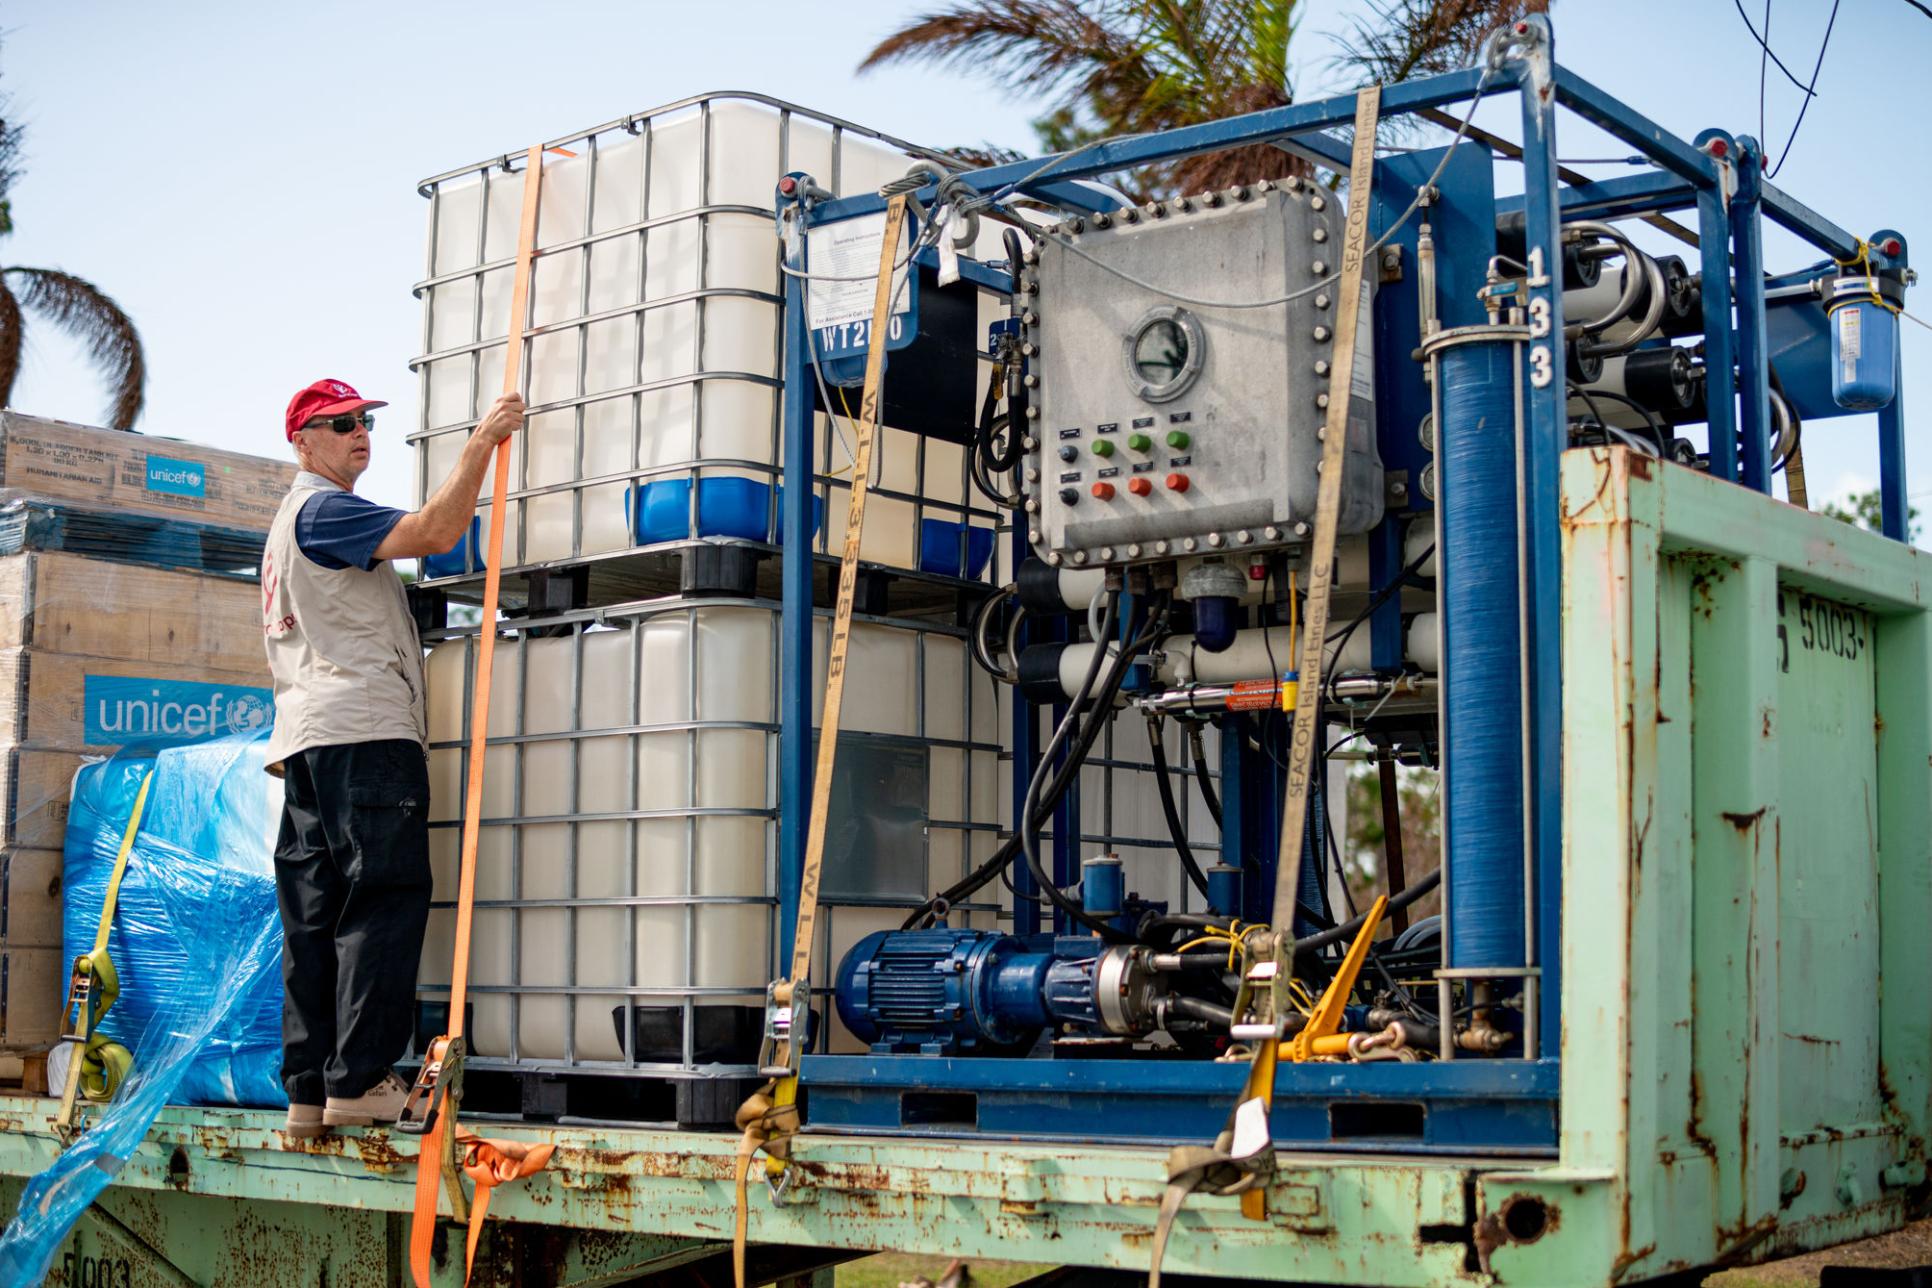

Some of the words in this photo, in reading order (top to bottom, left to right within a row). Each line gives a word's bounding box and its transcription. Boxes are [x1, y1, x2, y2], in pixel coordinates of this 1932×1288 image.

[1359, 101, 1377, 142] Lines
[1357, 147, 1372, 190] Island
[1345, 201, 1366, 273] SEACOR
[150, 468, 187, 484] unicef
[1313, 563, 1329, 600] LLC
[1306, 605, 1324, 652] Lines
[1301, 658, 1318, 708] Island
[100, 689, 223, 736] unicef
[1289, 714, 1312, 797] SEACOR
